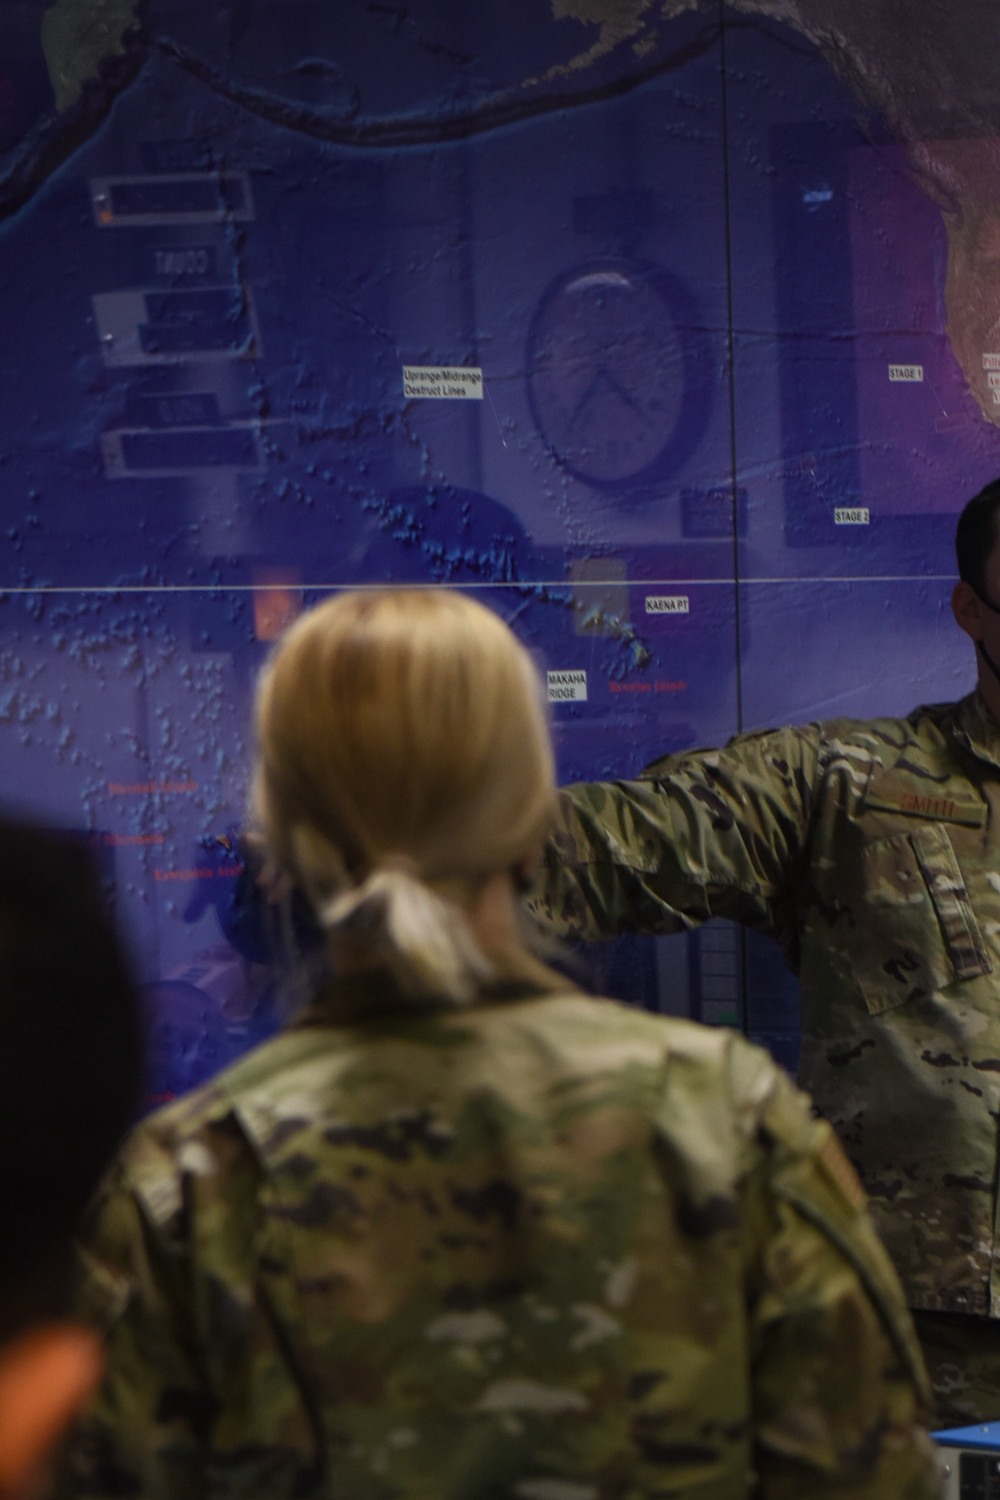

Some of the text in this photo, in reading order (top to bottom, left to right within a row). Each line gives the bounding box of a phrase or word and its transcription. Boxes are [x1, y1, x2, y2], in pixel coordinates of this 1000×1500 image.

[889, 368, 915, 378] STAGE
[405, 384, 466, 396] Destruct Lines
[835, 511, 862, 522] STAGE
[646, 599, 688, 611] KAENA PT
[549, 673, 586, 684] MAKAHA
[549, 687, 576, 698] RIDGE
